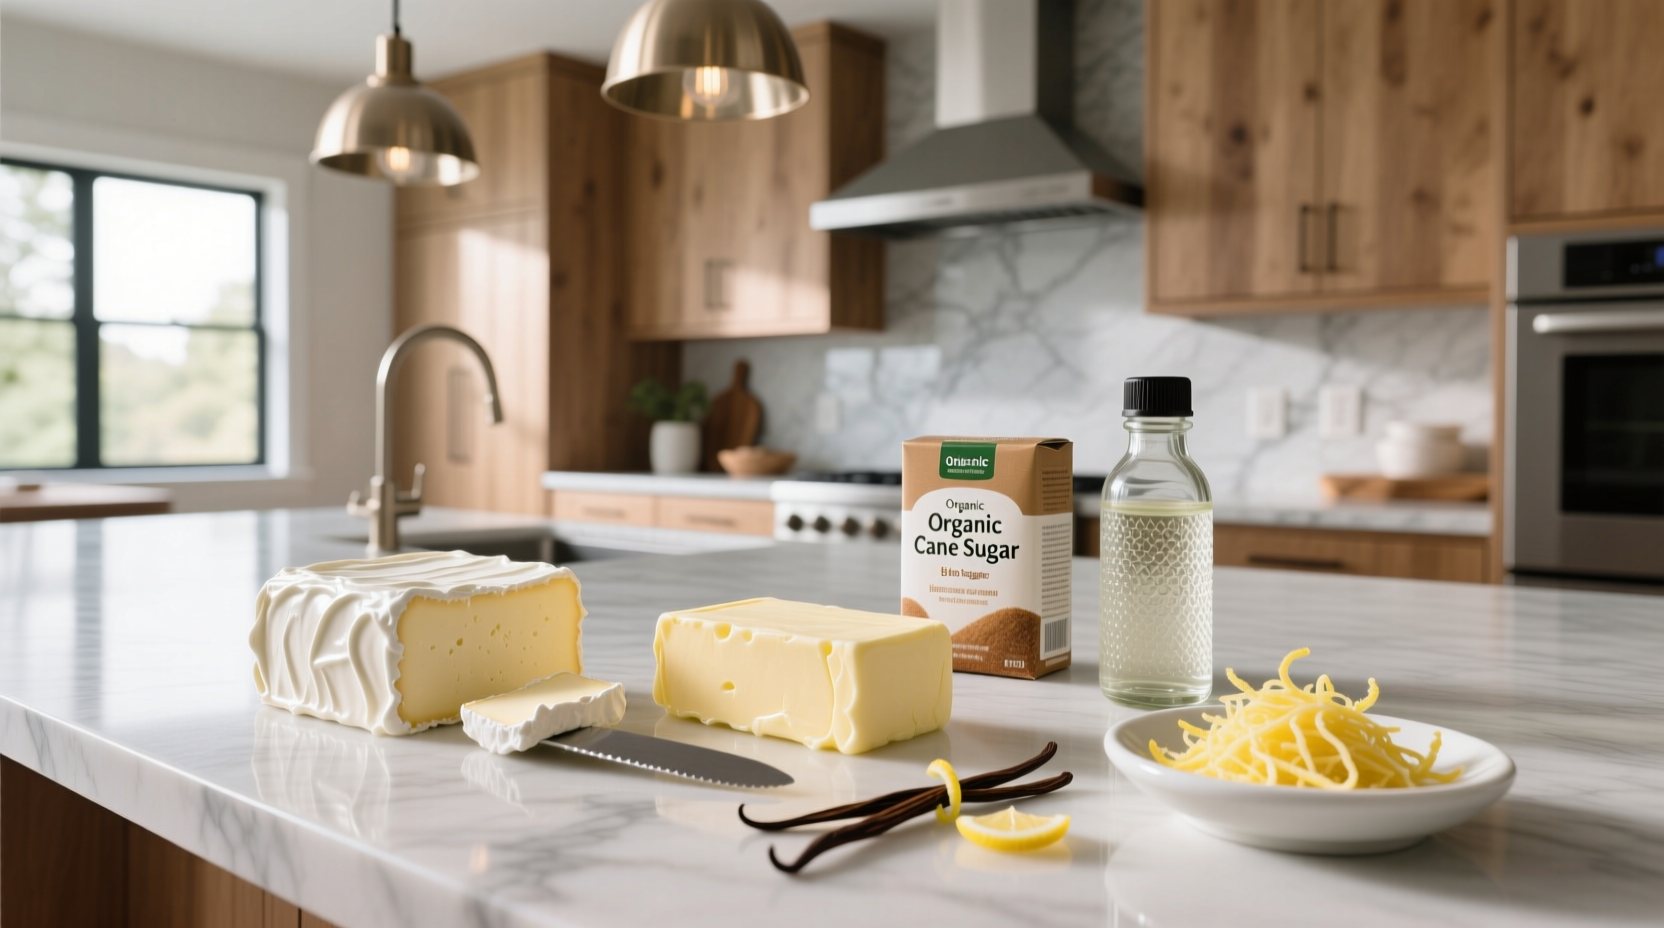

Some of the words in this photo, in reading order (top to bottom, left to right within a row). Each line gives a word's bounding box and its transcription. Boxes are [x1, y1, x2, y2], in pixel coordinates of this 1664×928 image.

[945, 498, 985, 513] Organic
[928, 512, 1002, 538] Organic
[914, 535, 959, 556] Cane
[963, 538, 1020, 564] Sugar
